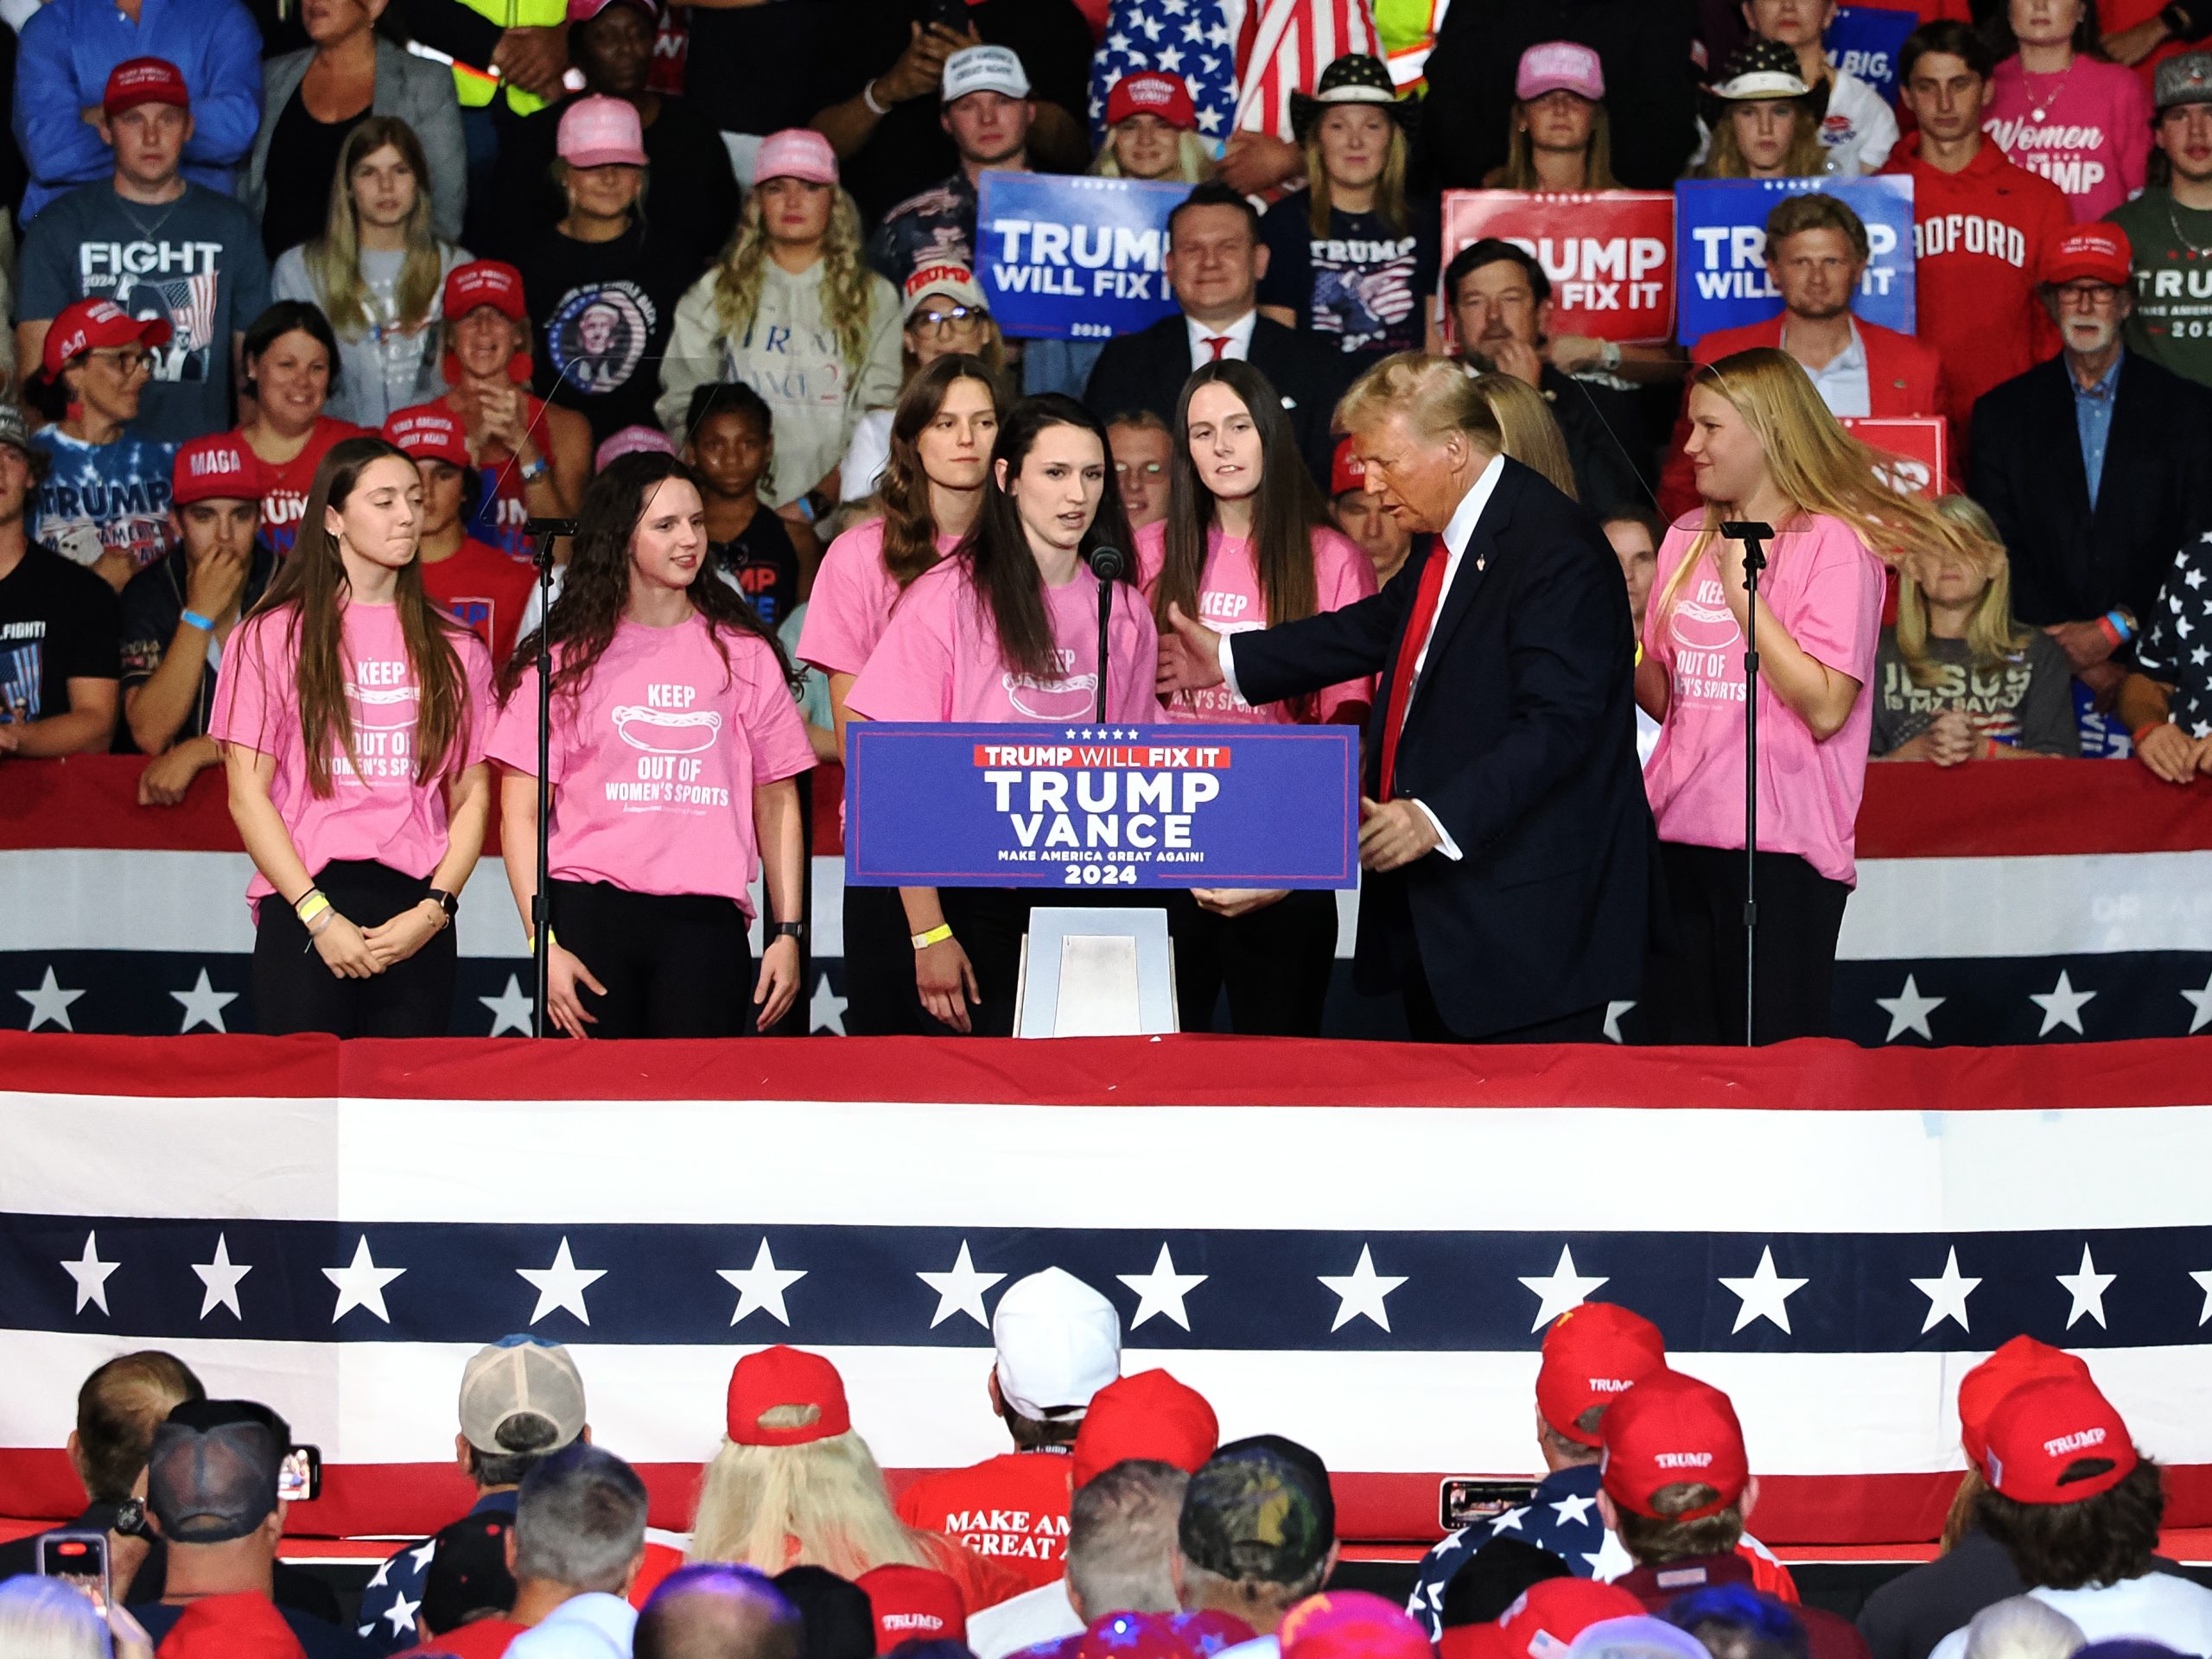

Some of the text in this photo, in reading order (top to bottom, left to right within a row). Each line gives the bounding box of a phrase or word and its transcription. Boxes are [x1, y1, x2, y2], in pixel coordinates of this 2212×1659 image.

[1982, 114, 2105, 150] Women
[79, 240, 223, 274] FIGHT
[994, 219, 1171, 272] TRUM
[1309, 236, 1417, 263] TRUMP
[1692, 223, 1897, 270] TRP
[905, 264, 972, 298] TRUMP
[993, 263, 1085, 296] WILL
[1093, 270, 1152, 300] FIX
[1861, 266, 1897, 296] IT
[1561, 283, 1663, 311] FIX IT
[190, 449, 241, 476] MAGA
[39, 477, 173, 518] TRUMP
[1199, 590, 1248, 617] KEEP
[358, 661, 405, 685] KEEP
[1676, 650, 1726, 678] OUT OF
[647, 683, 696, 709] KEEP
[1910, 694, 1944, 715] MY
[638, 756, 702, 783] OUT OF
[984, 747, 1220, 767] TRUMP WILL FIX IT
[605, 781, 729, 807] WOMEN'S SPORTS
[984, 770, 1220, 813] TRUMP
[1010, 813, 1192, 849] VANCE
[998, 850, 1205, 862] MAKE AMERICA GREAT AGAIN!
[1065, 864, 1138, 885] 2024
[2044, 1427, 2107, 1458] TRUMP
[1654, 1452, 1713, 1468] TRUMP
[944, 1510, 1030, 1535] MAKE
[961, 1533, 1056, 1560] GREAT
[882, 1612, 944, 1631] TRUMP
